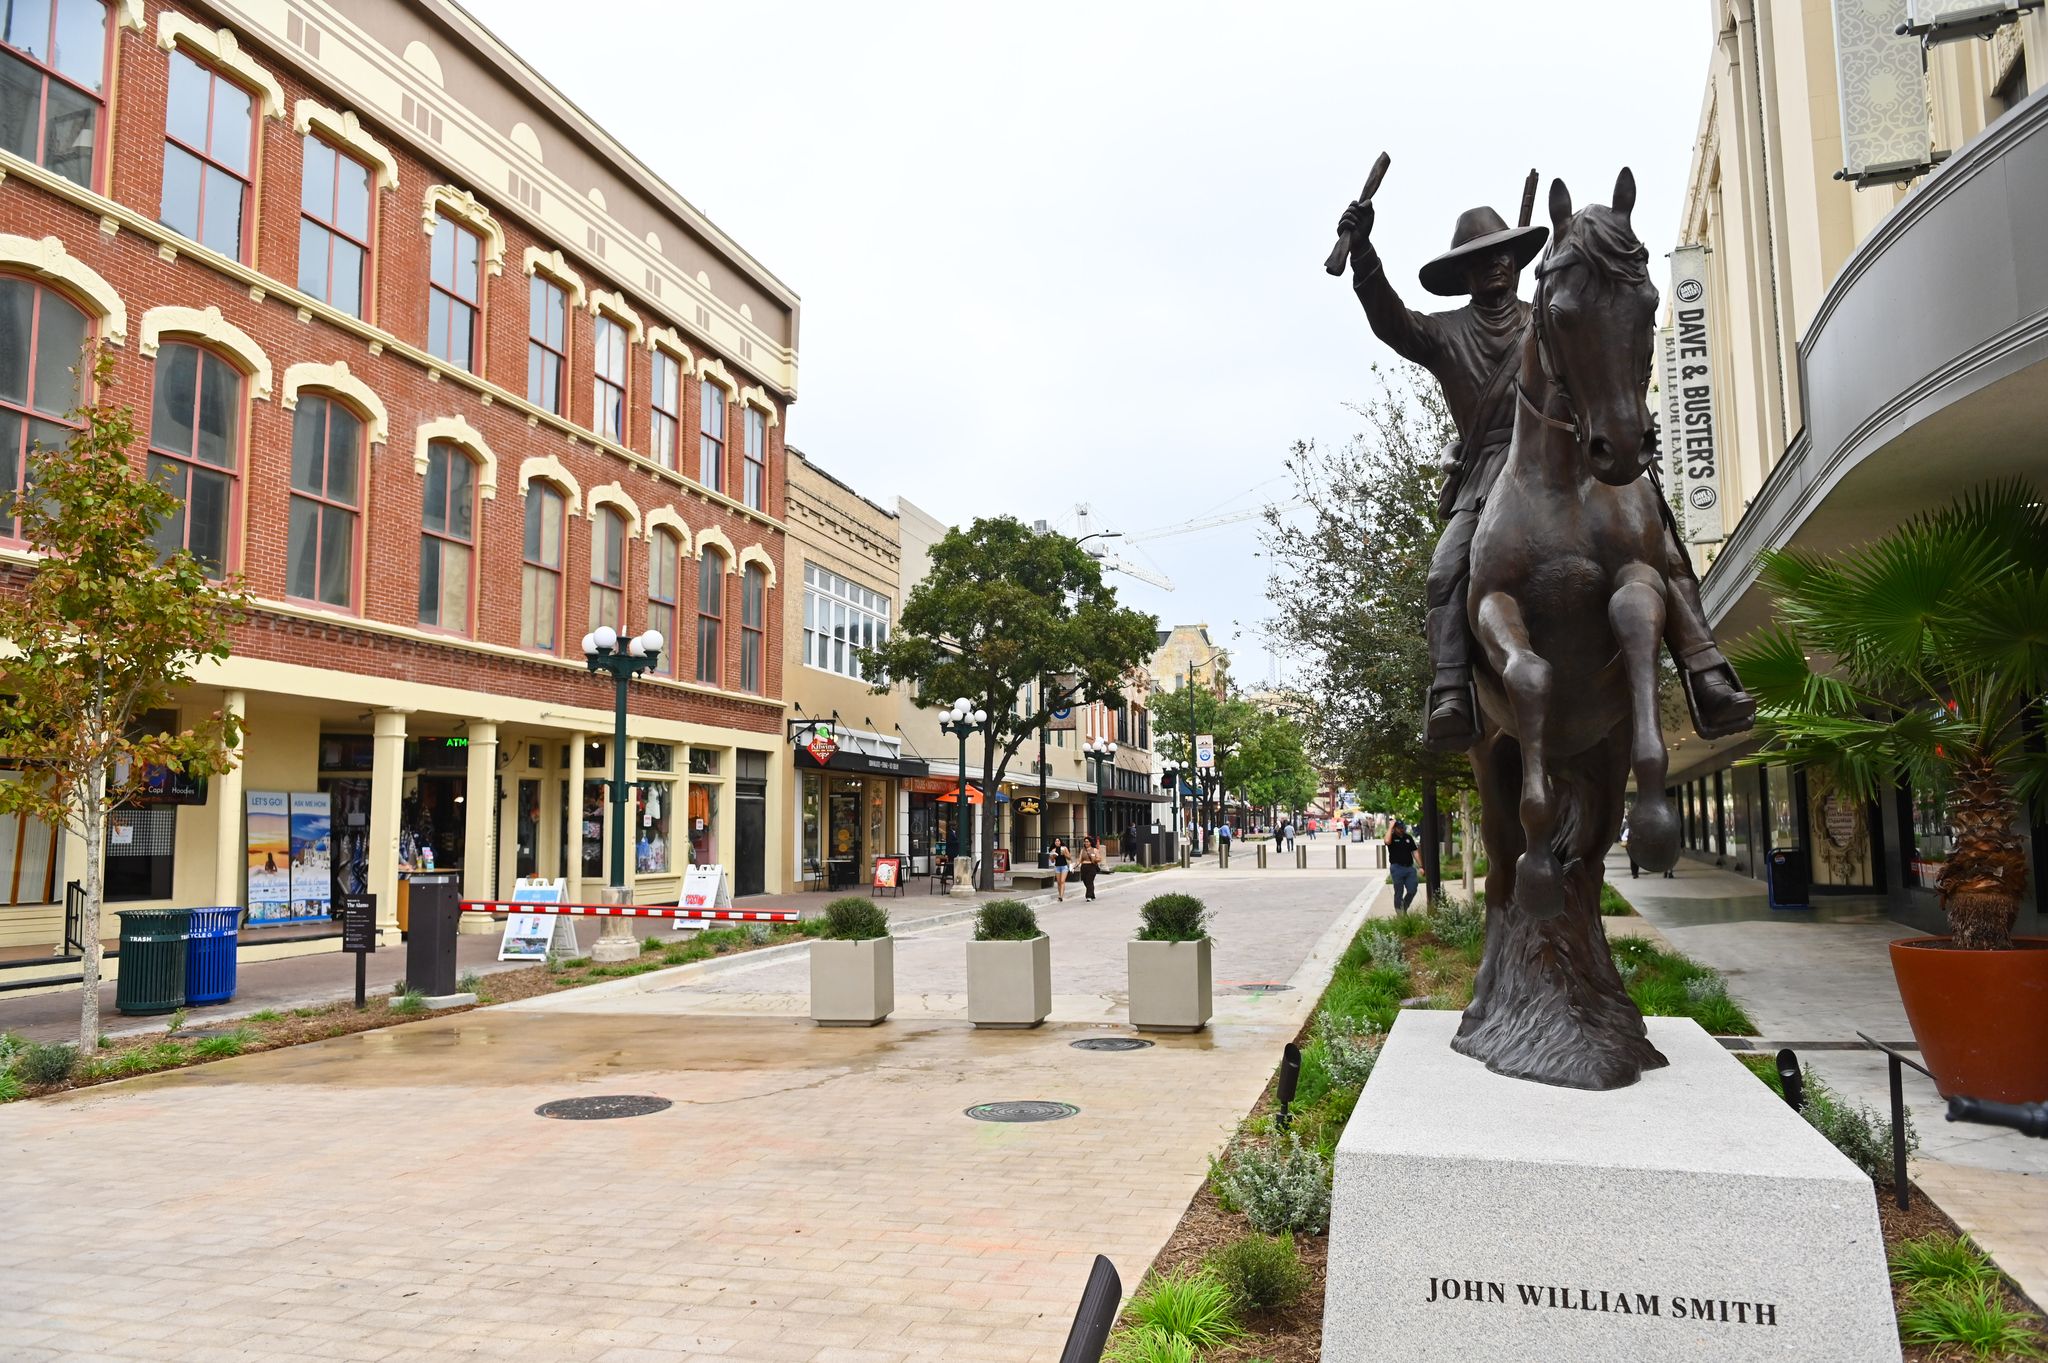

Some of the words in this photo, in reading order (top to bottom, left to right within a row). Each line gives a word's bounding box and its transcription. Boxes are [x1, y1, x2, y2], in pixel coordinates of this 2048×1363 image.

[1678, 308, 1708, 360] DAVE
[1665, 337, 1678, 393] BATTLE
[1682, 364, 1708, 380] &
[1669, 395, 1680, 424] FOR
[1684, 385, 1715, 480] BUSTER'S
[1671, 429, 1684, 475] TEXAS
[446, 738, 467, 747] ATM
[171, 786, 194, 796] Hoodies
[252, 797, 267, 806] LET'S
[268, 798, 283, 806] GO!
[1426, 1276, 1505, 1304] JOHN
[1516, 1284, 1662, 1317] WILLIAM
[1671, 1296, 1778, 1327] SMITH
